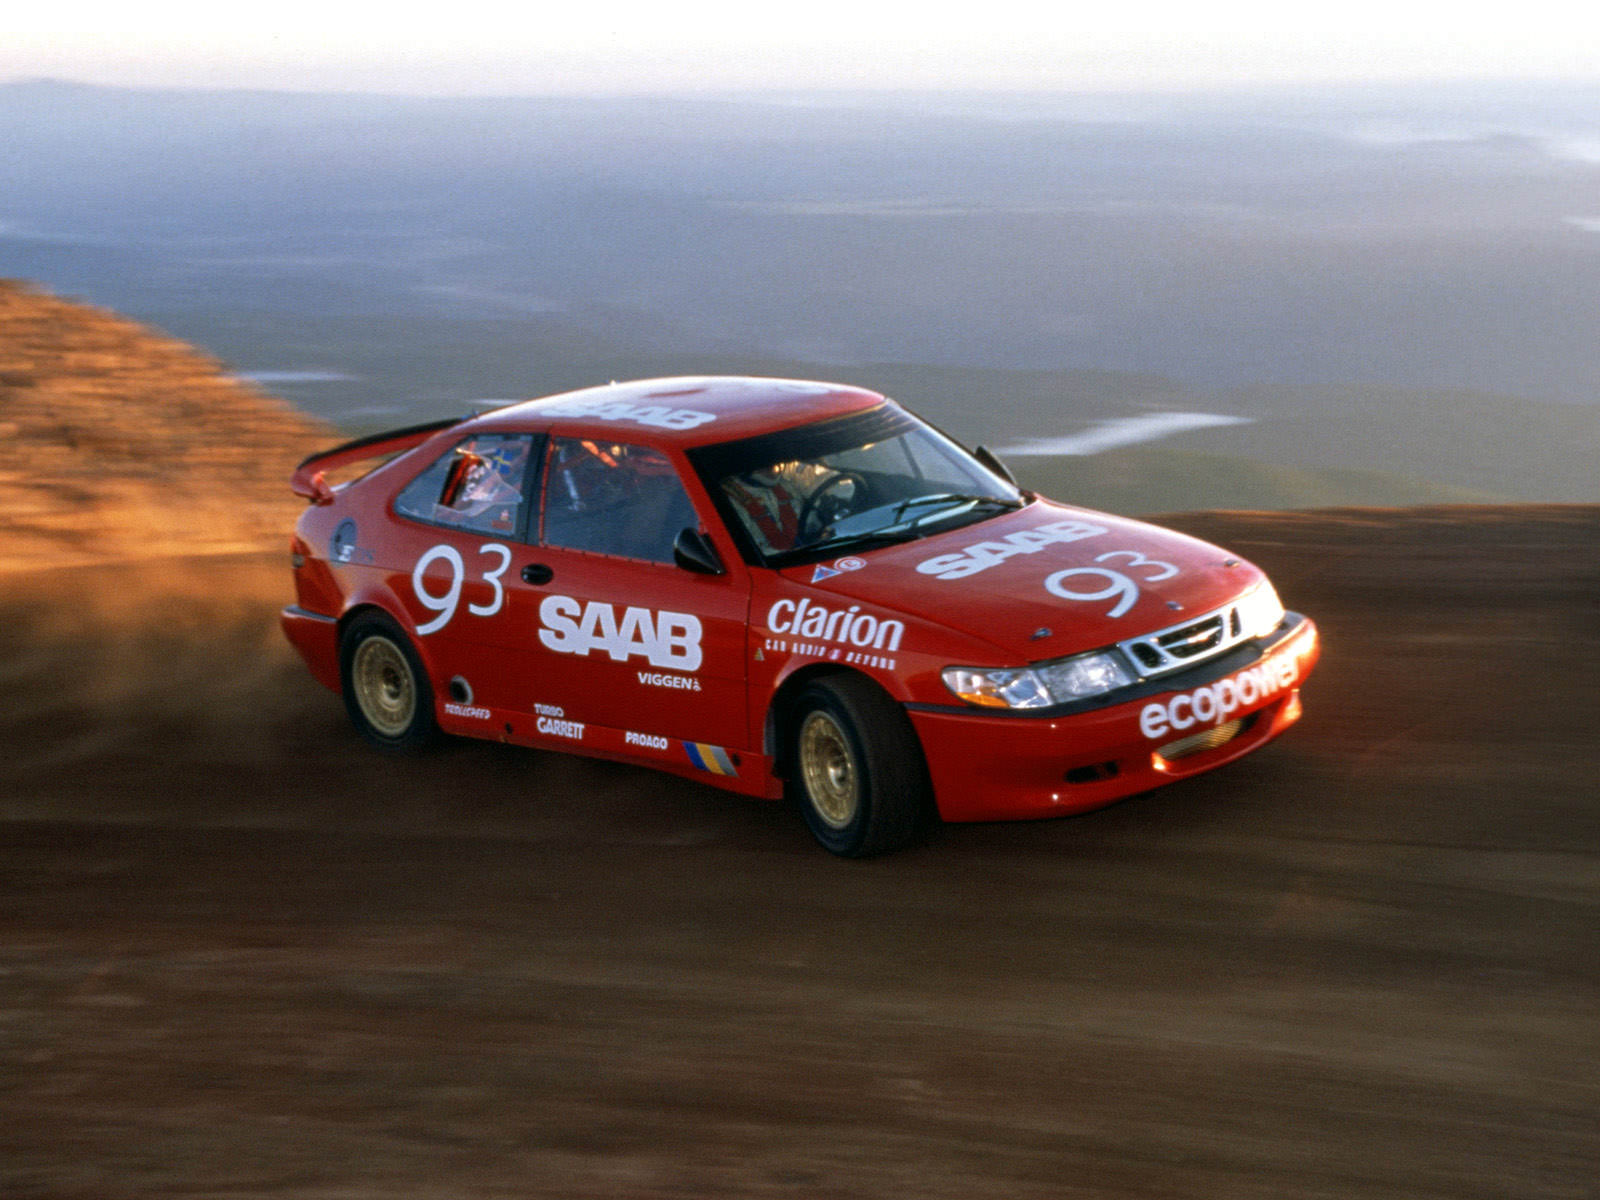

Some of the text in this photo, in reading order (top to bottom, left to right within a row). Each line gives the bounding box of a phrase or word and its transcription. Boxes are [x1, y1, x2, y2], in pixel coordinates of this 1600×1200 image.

[915, 520, 1109, 580] SAAB
[412, 543, 511, 635] 93
[1044, 550, 1180, 618] 93
[538, 595, 703, 671] SAAB
[765, 639, 786, 652] CAR
[793, 642, 826, 657] AUDIO
[637, 672, 693, 690] VIGGEN
[537, 717, 585, 739] GARRETT
